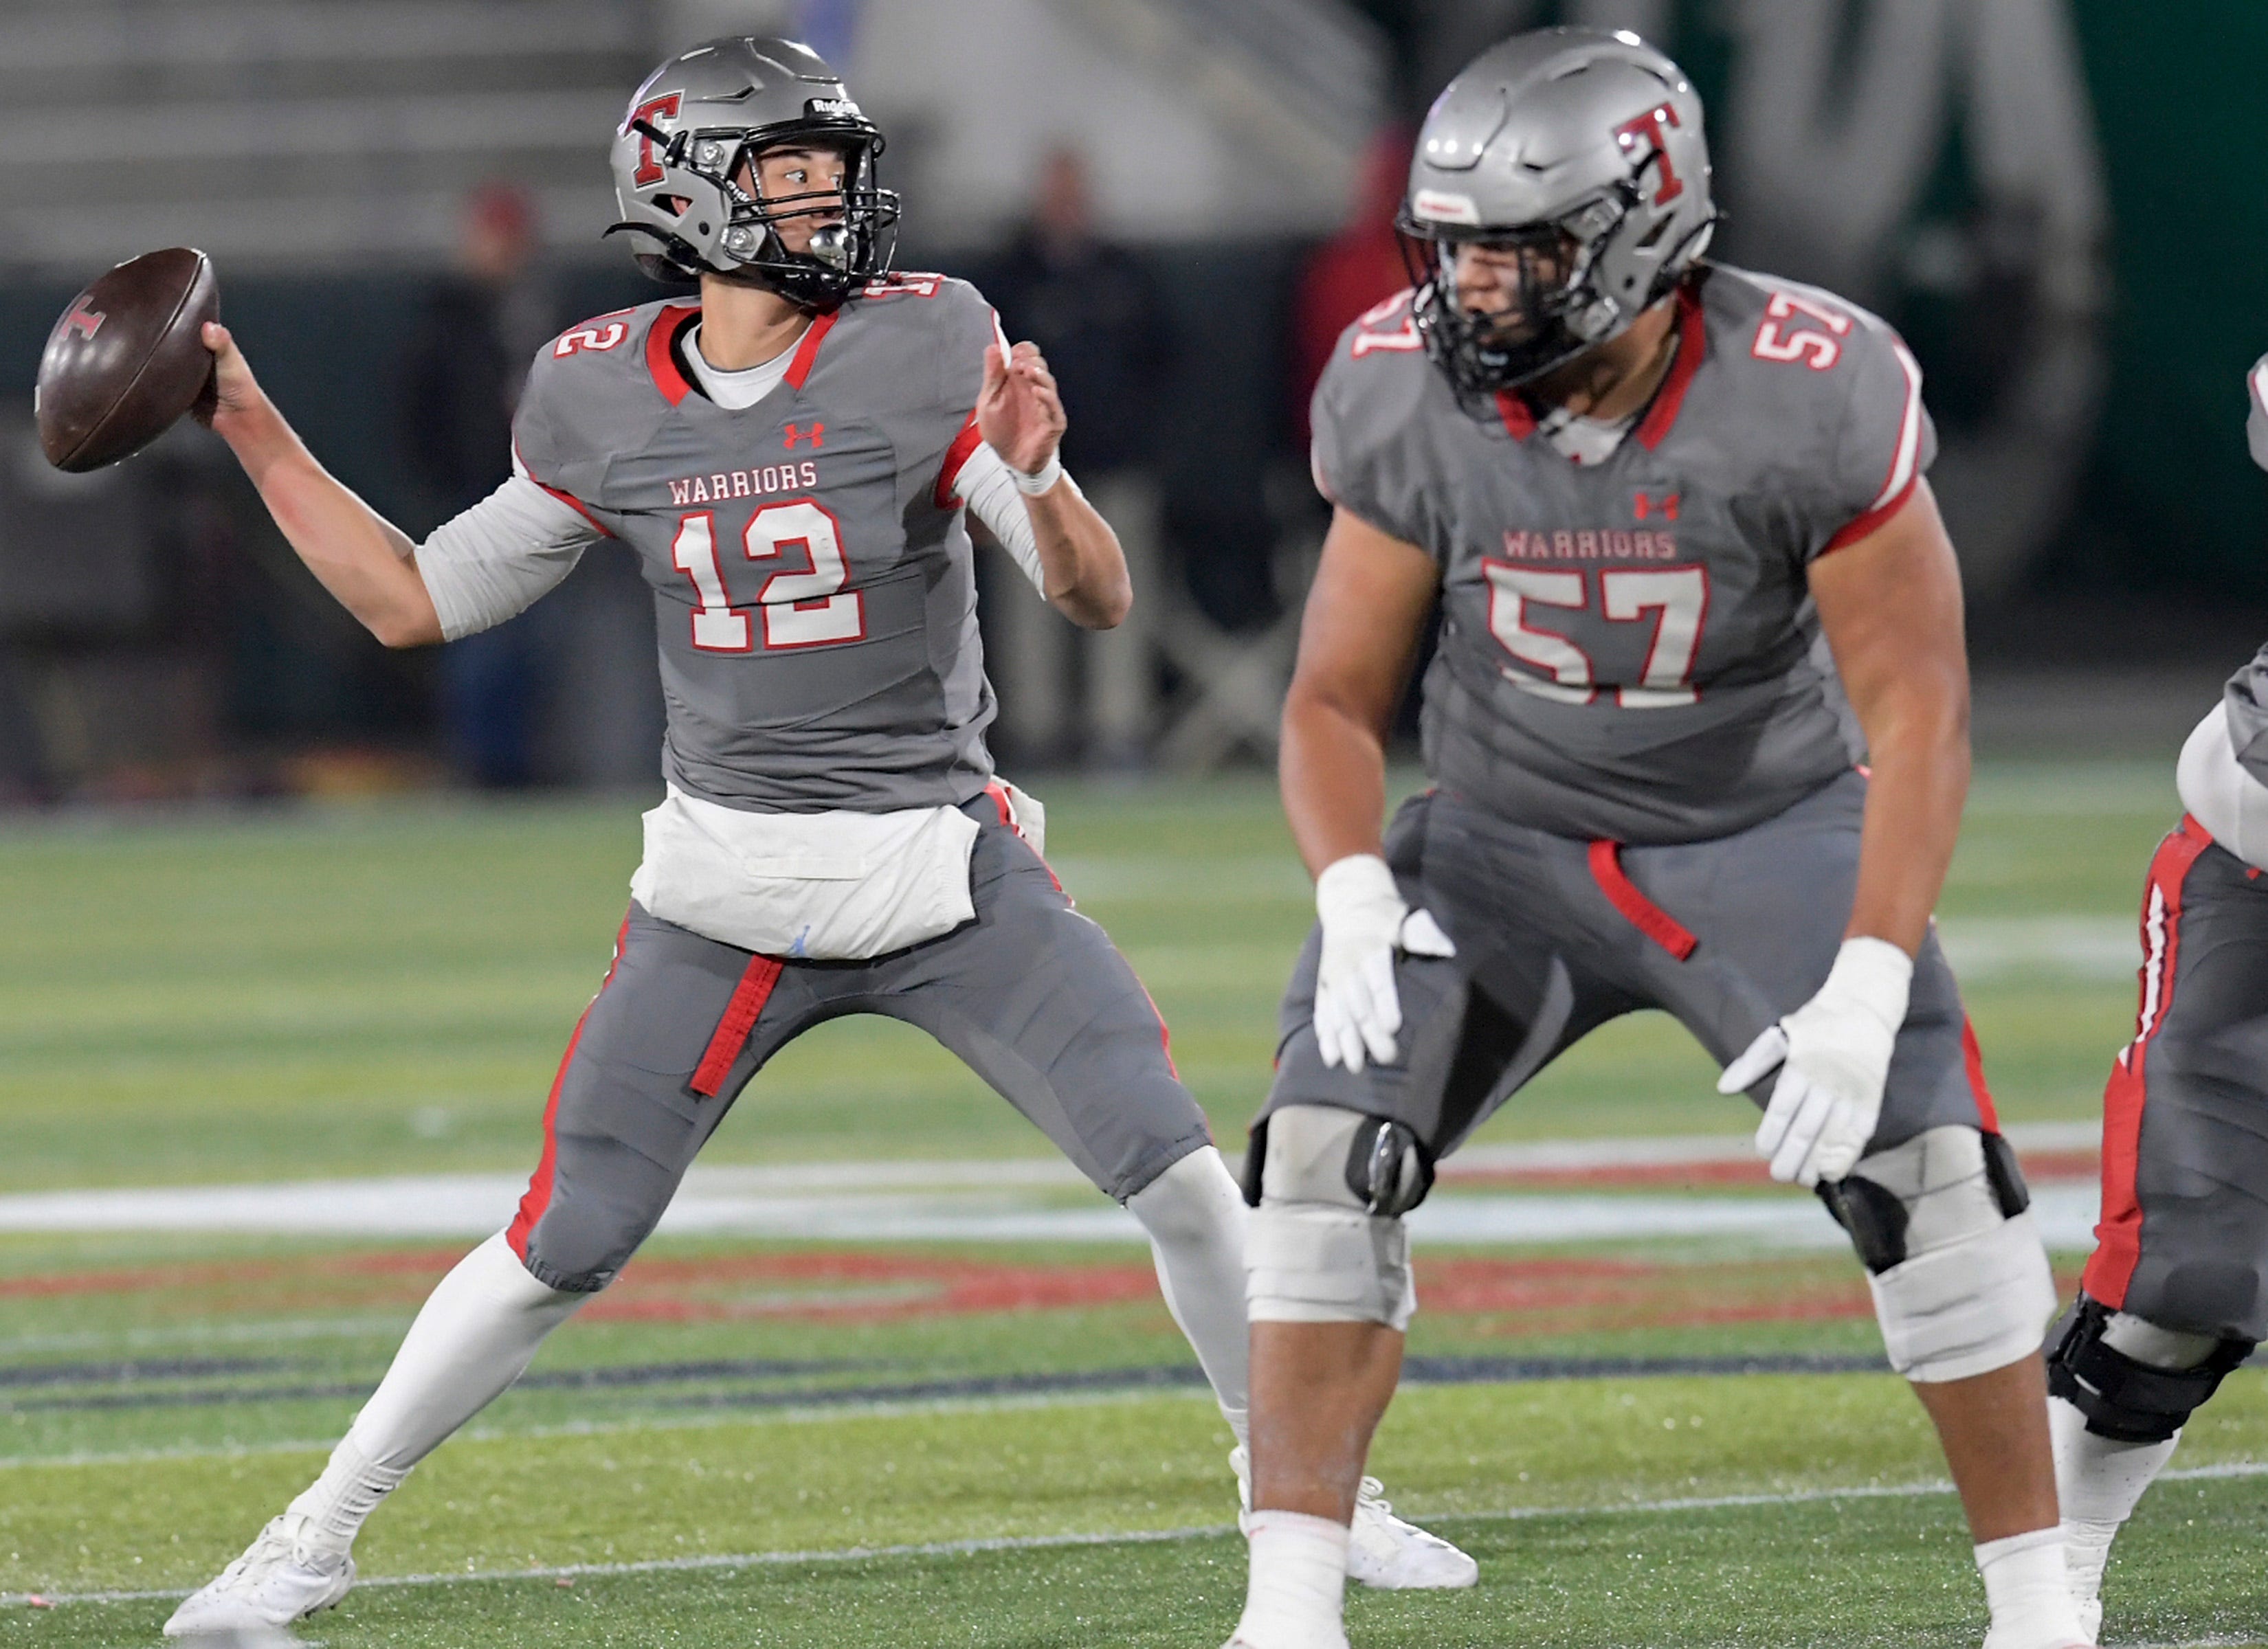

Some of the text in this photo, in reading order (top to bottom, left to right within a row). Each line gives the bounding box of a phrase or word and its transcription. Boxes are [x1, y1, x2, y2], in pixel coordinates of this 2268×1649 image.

[621, 89, 686, 192] T
[1611, 101, 1683, 207] T
[863, 271, 946, 300] 1
[553, 306, 636, 359] 2
[1750, 290, 1854, 372] 57
[668, 462, 818, 506] WARRIORS
[671, 496, 867, 653] 12
[1502, 528, 1678, 559] WARRIORS
[1480, 556, 1710, 709] 57
